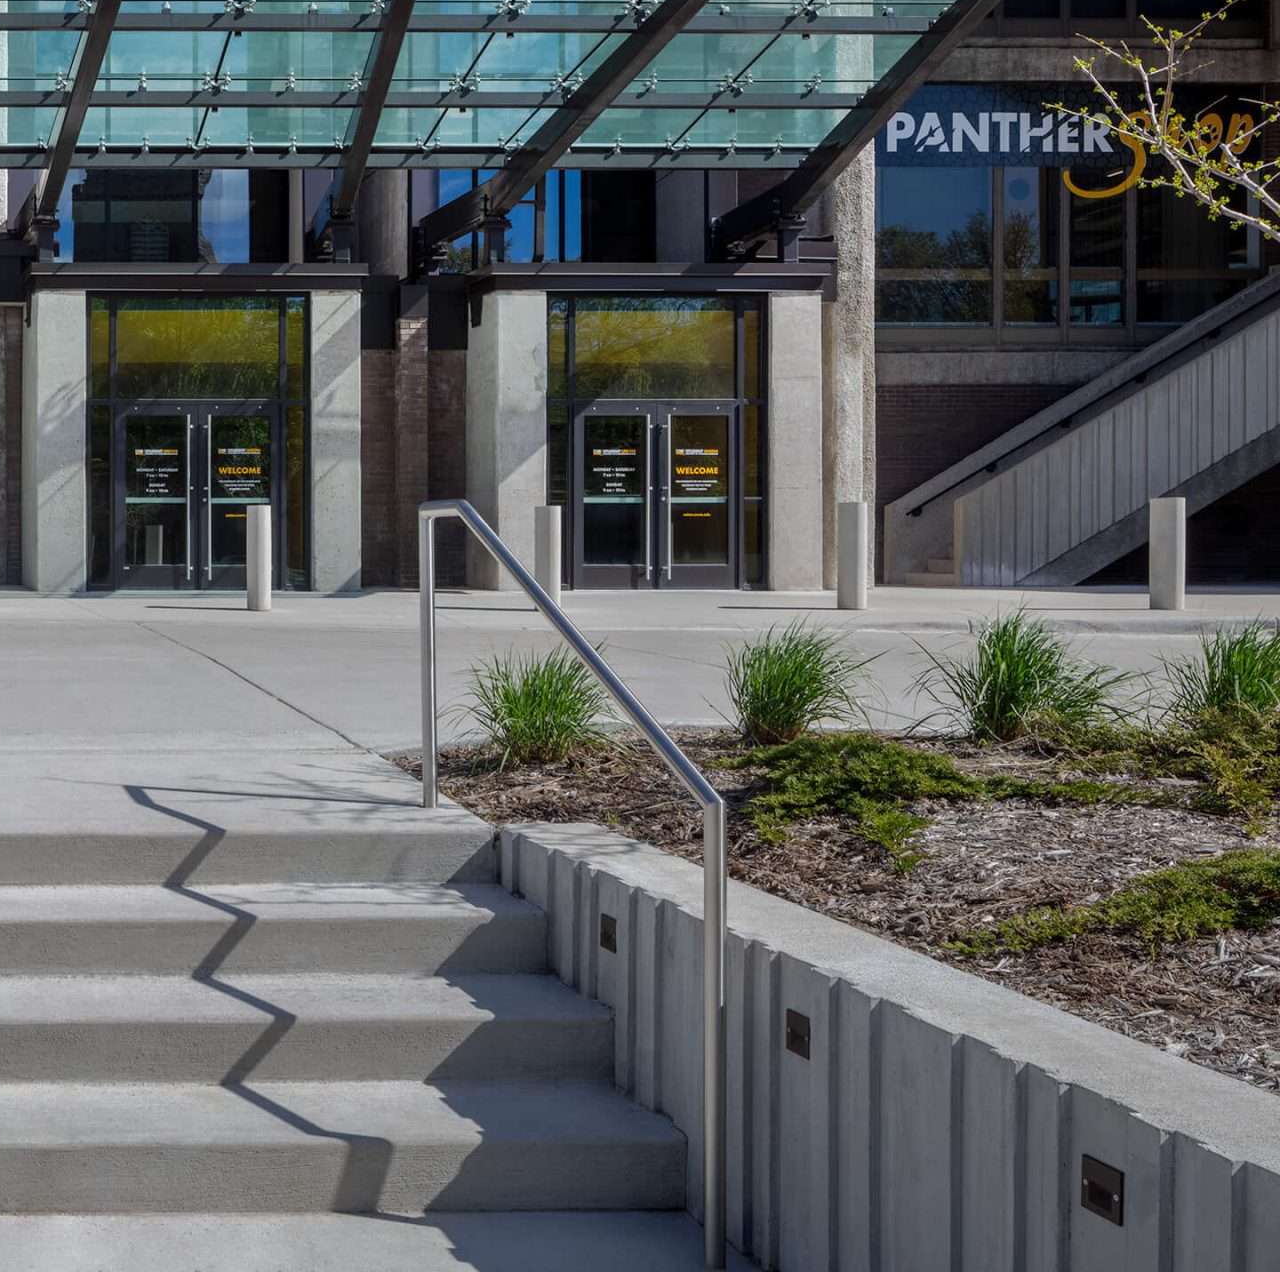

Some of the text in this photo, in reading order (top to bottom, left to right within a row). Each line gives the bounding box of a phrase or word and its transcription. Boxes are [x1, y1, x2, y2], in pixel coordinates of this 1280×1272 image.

[885, 111, 1114, 153] PANTHER
[218, 466, 262, 475] WELCOME
[675, 466, 719, 475] WELCOME
